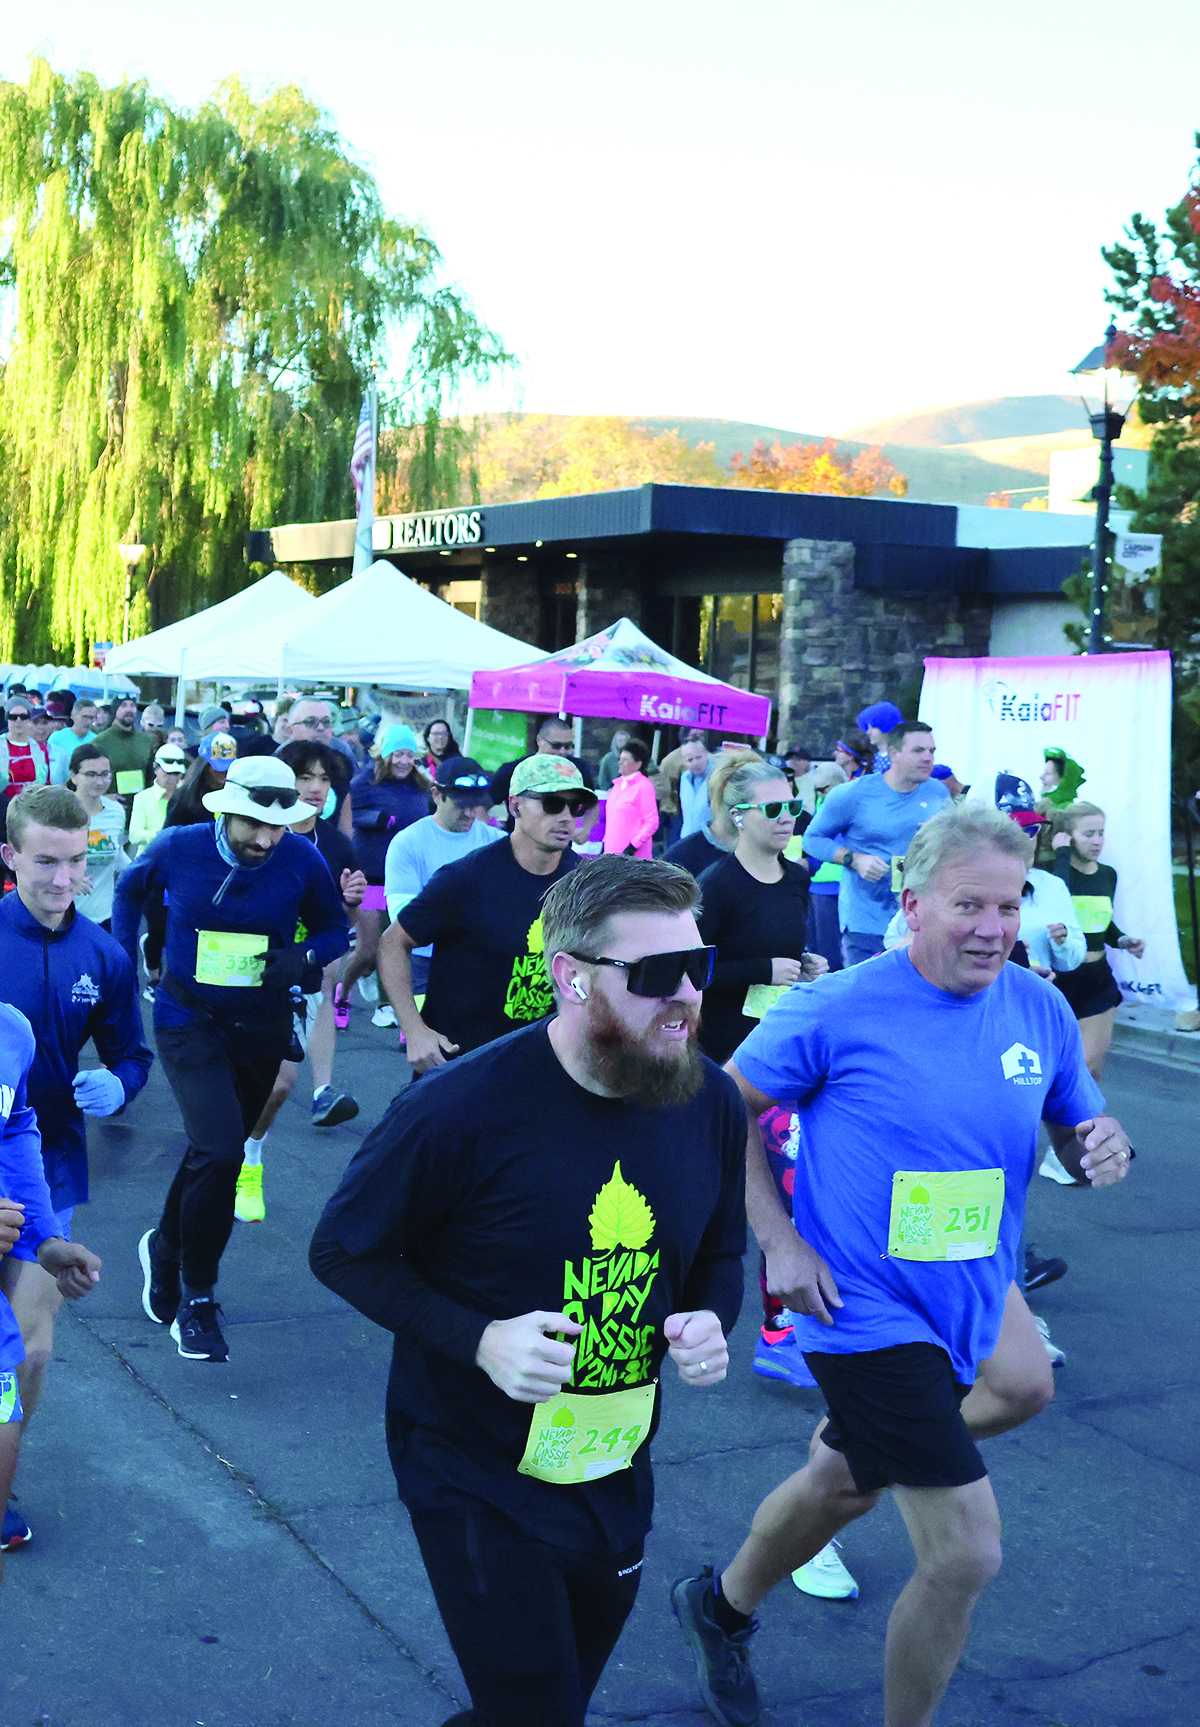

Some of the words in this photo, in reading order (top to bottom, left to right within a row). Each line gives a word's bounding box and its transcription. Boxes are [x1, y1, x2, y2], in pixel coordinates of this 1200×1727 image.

[391, 511, 481, 549] REALTORS
[640, 694, 728, 726] KaiaFIT
[1000, 693, 1081, 721] KaiaFIT
[512, 956, 546, 977] NEV
[1013, 1077, 1042, 1086] HILLTOP
[944, 1205, 991, 1233] 251
[563, 1248, 660, 1300] NEVADA
[601, 1272, 658, 1323] DAY
[534, 1442, 571, 1461] CLASSIC
[578, 1424, 642, 1455] 244
